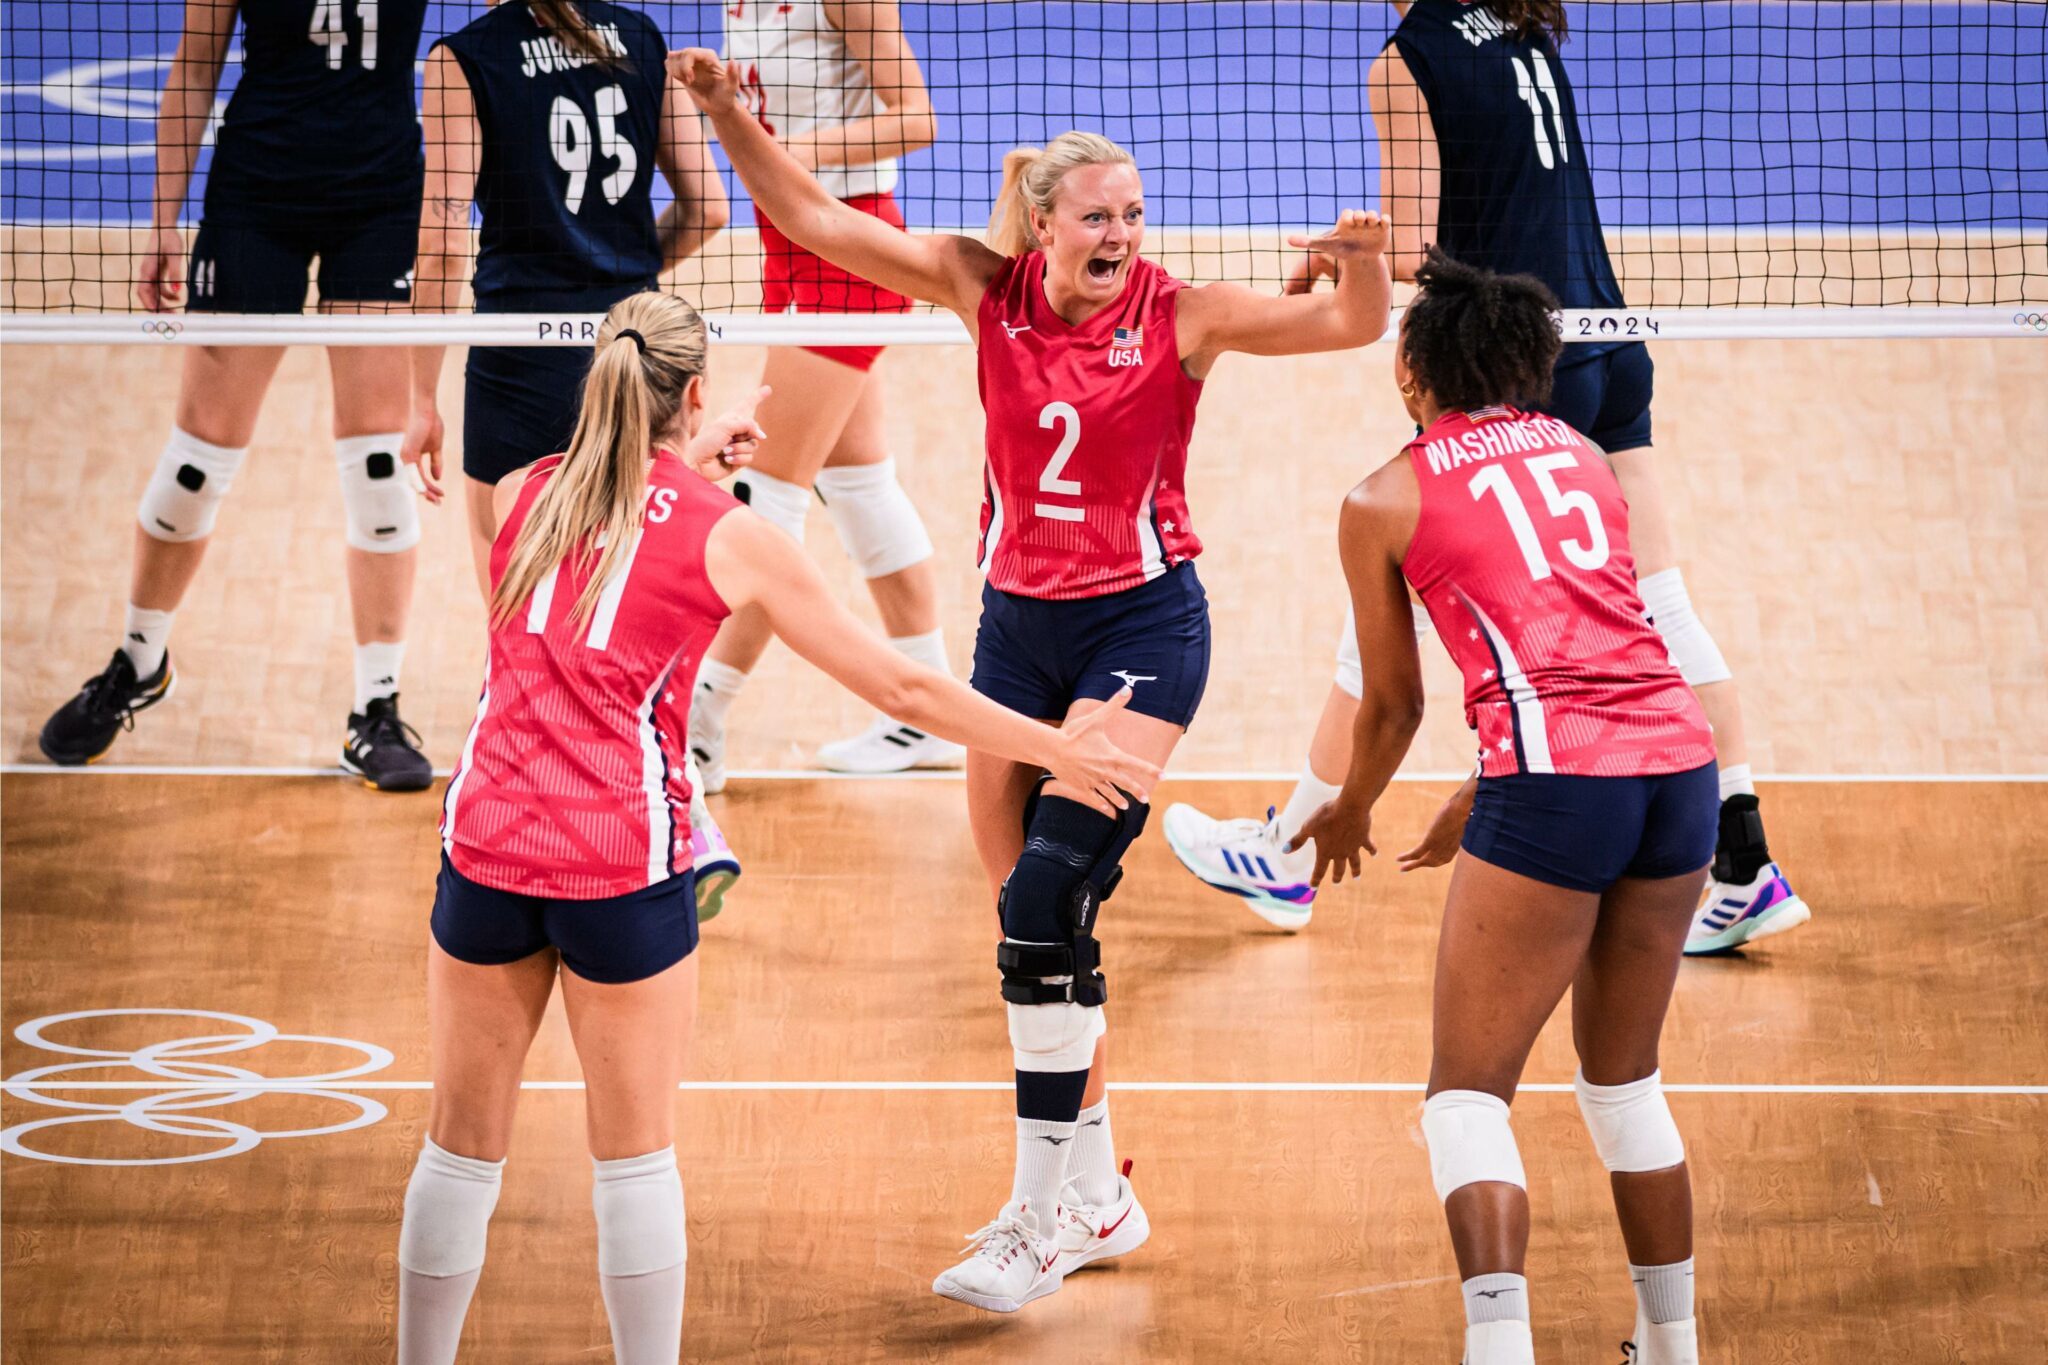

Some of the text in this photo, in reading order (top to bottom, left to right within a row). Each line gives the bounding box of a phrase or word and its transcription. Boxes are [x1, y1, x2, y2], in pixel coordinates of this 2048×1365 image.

[308, 0, 379, 71] 41
[549, 83, 638, 215] 95
[1510, 48, 1569, 170] 11
[538, 321, 596, 340] PAR
[1107, 347, 1144, 368] USA
[1038, 401, 1082, 496] 2
[1467, 451, 1610, 582] 15
